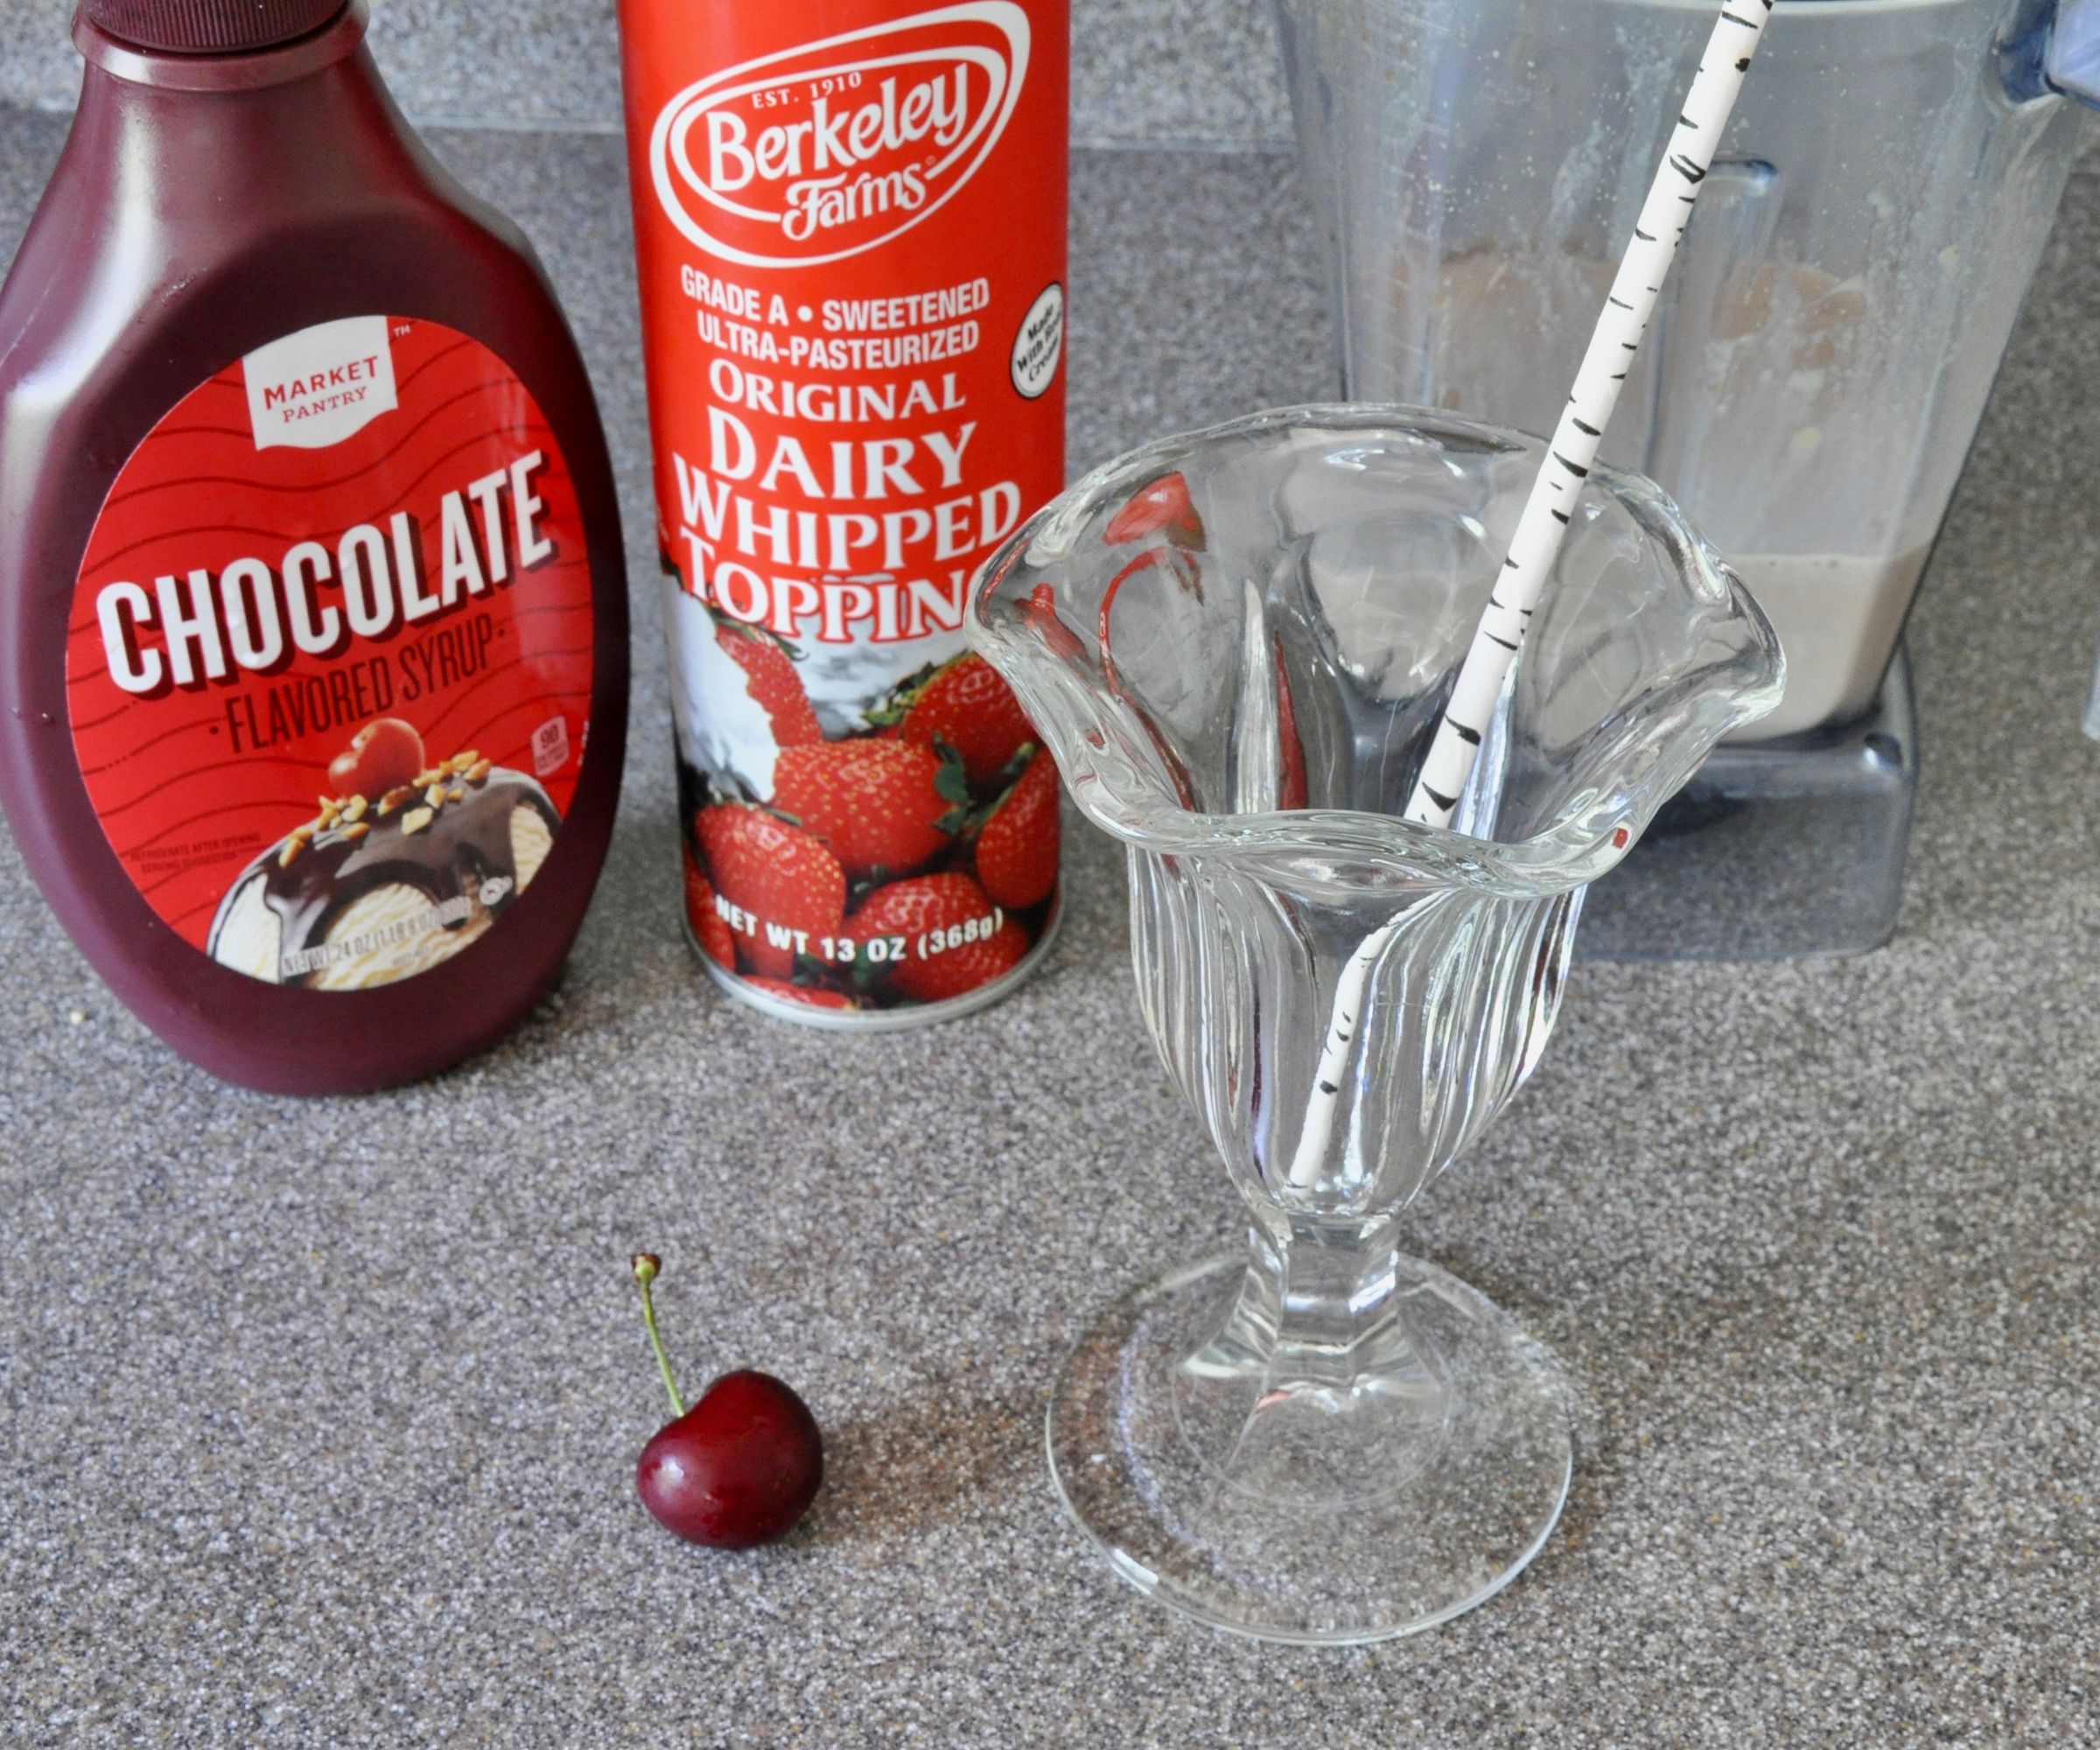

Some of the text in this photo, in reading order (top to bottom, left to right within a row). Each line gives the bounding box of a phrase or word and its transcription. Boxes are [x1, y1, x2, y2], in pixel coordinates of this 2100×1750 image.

[752, 71, 862, 108] EST. 1910
[706, 62, 968, 191] Berkeley
[781, 163, 926, 241] Farms
[681, 264, 990, 332] GRADE A SWEETENED
[696, 320, 980, 371] ULTRA-PASTEURIZED
[263, 354, 378, 411] MARKET
[283, 386, 367, 424] PANTRY
[709, 357, 966, 423] ORIGINAL
[707, 404, 978, 500] DAIRY
[672, 451, 1021, 571] WHIPPED
[95, 449, 558, 696] CHOCOLATE
[679, 525, 966, 642] TOPPIN
[225, 614, 493, 754] FLAVORED SYRUP
[716, 894, 1004, 962] NET WT 13 OZ (368g)
